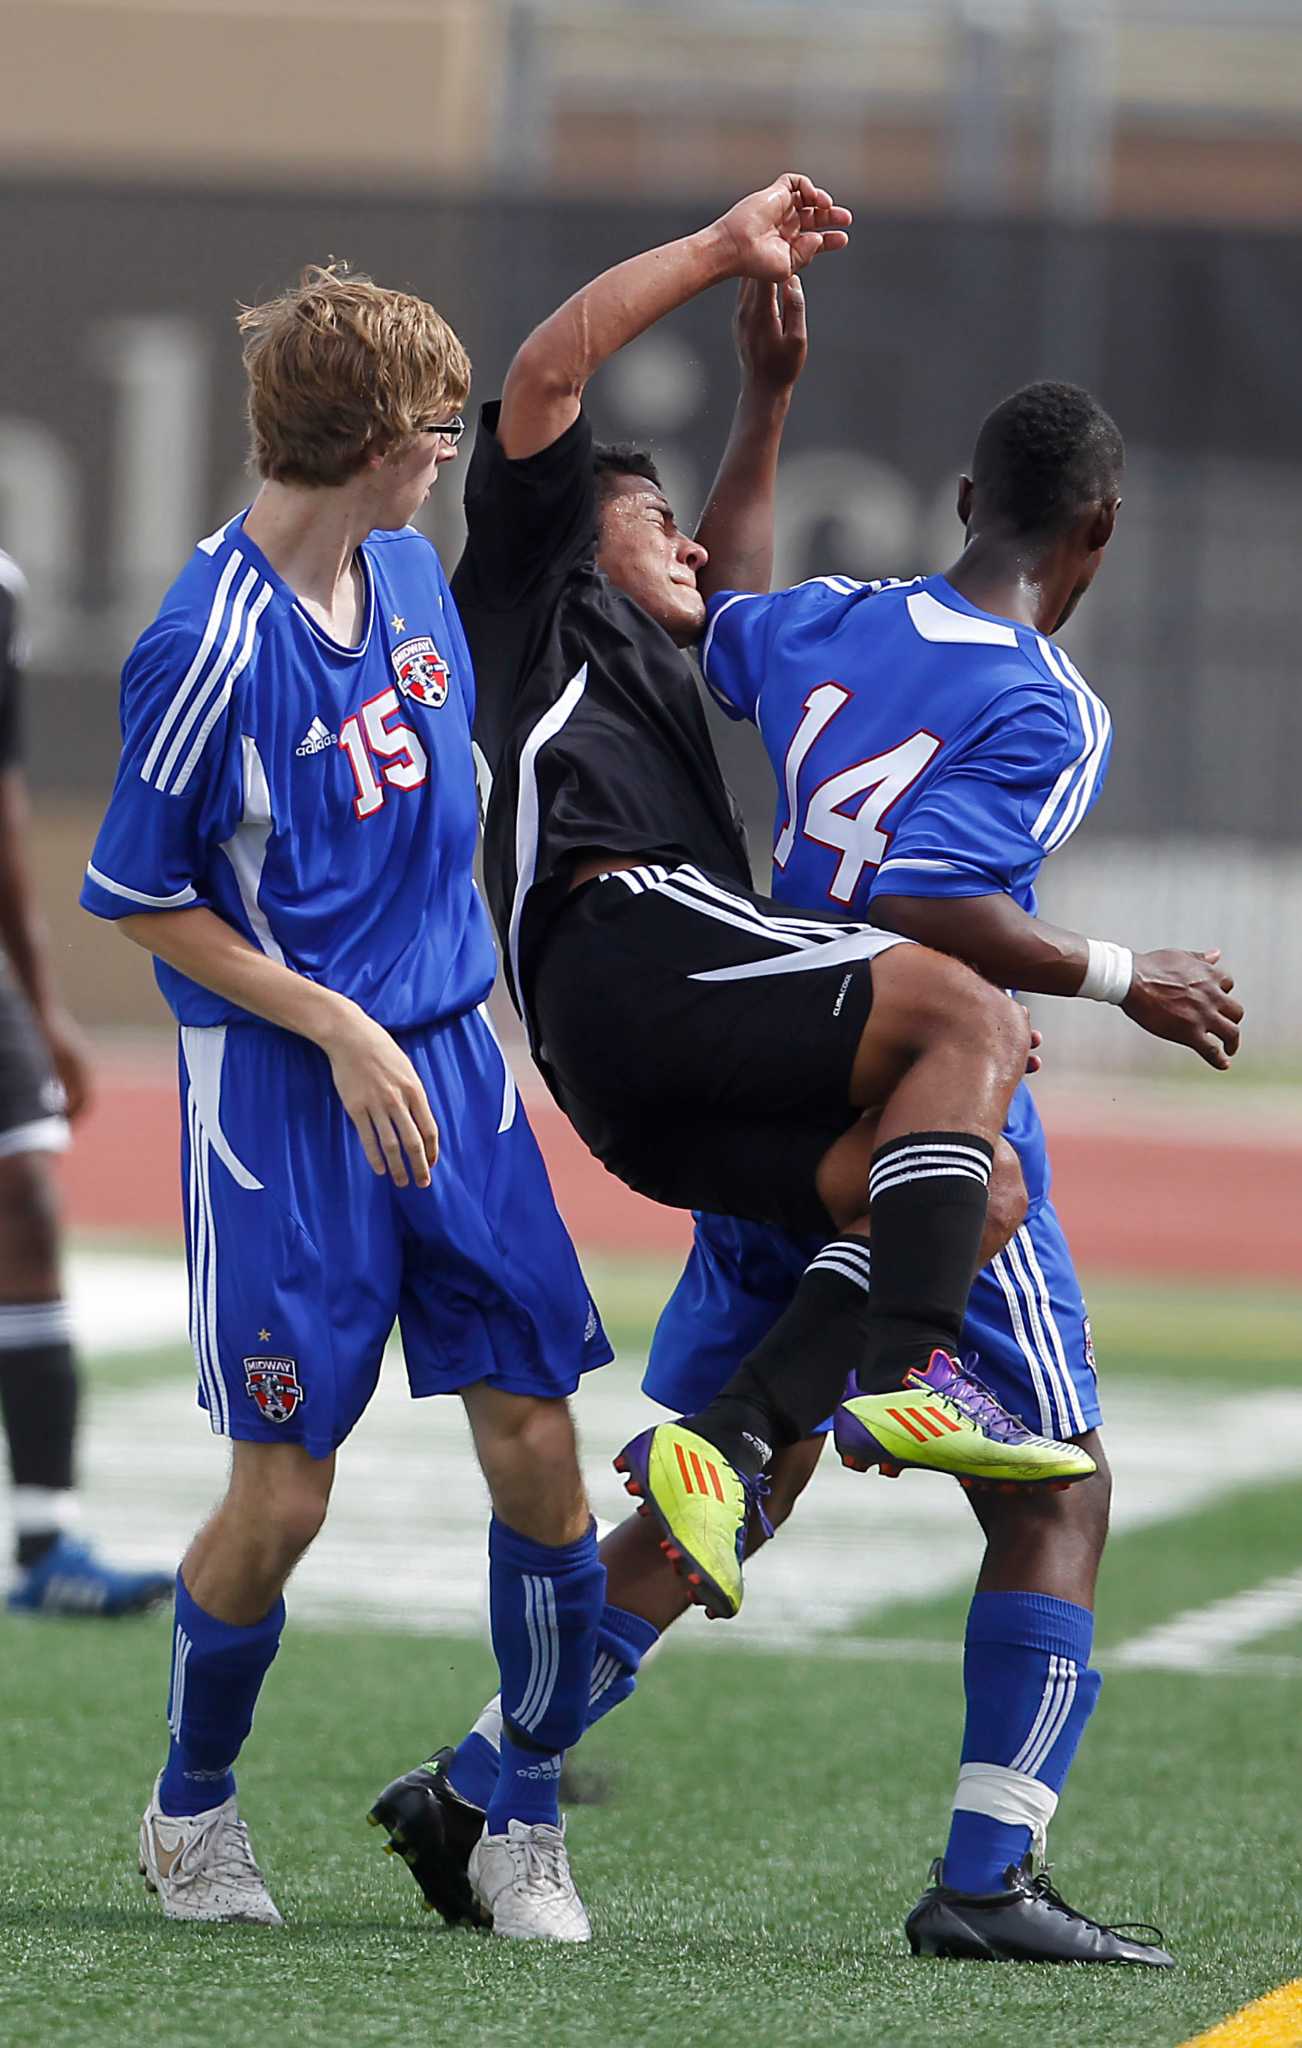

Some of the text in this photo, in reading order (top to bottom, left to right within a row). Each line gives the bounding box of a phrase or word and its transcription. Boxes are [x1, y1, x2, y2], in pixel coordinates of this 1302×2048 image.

[393, 640, 431, 664] MIDWAY
[296, 734, 337, 757] adidas
[339, 686, 428, 819] 15
[773, 680, 944, 906] 14
[247, 1361, 291, 1373] MIDWAY
